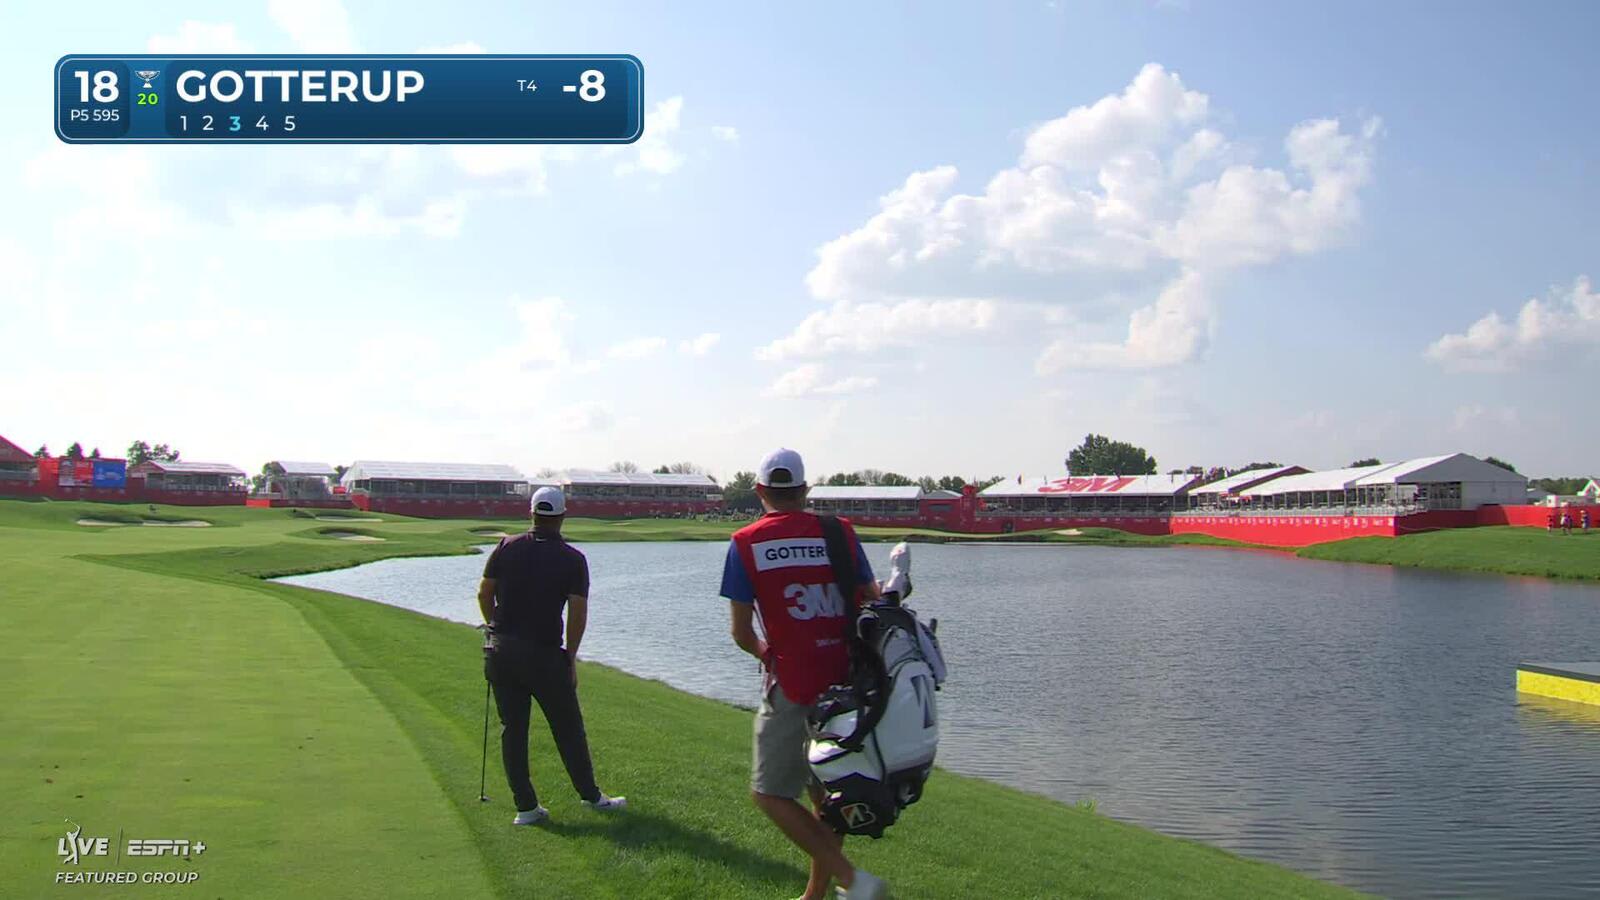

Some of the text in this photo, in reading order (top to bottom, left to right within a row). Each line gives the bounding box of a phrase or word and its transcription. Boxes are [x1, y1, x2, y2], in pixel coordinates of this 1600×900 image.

[1038, 477, 1138, 493] 3M
[765, 545, 827, 561] GOTTER
[784, 583, 845, 620] 3M
